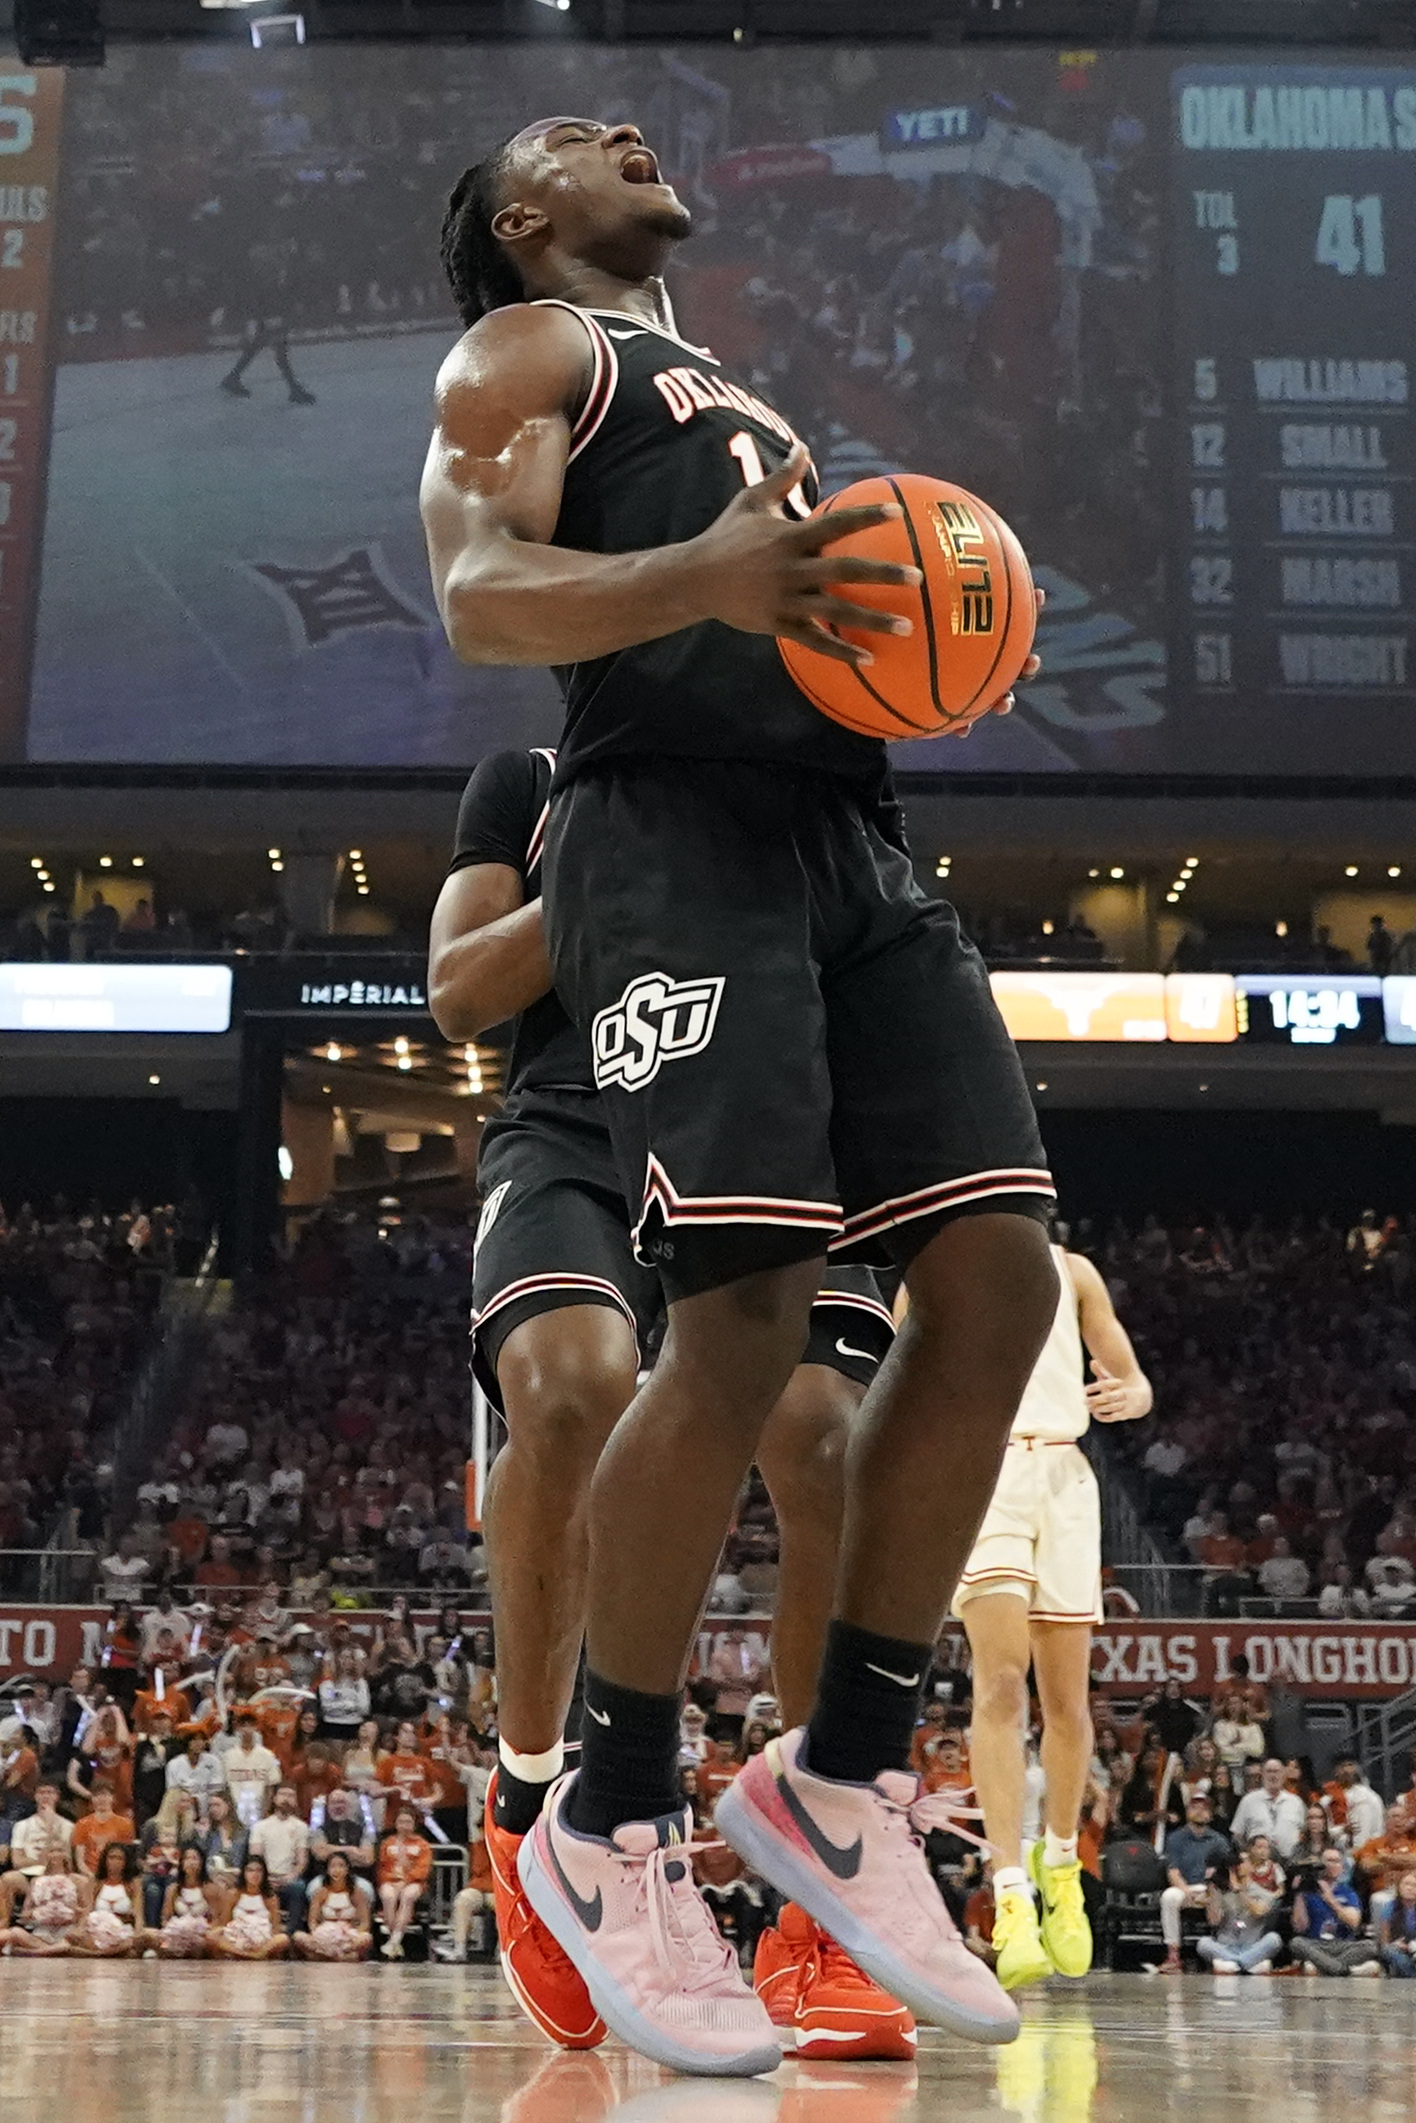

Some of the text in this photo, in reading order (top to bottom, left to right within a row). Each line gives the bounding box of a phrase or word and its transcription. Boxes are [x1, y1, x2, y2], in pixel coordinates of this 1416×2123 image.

[896, 107, 970, 141] YETI
[2, 229, 24, 268] 2
[1217, 234, 1239, 275] 3
[1315, 195, 1386, 276] 41
[1195, 359, 1407, 402] 5 WILLIAMS
[653, 367, 801, 446] OKLAHO
[1191, 424, 1388, 468] 12 SMALL
[1191, 488, 1393, 534] 14 KELLER
[1190, 556, 1400, 606] 32 MARSH
[1197, 633, 1407, 683] 51 WRIGHT
[592, 971, 726, 1093] OSU
[1092, 1635, 1416, 1684] XAS LONGHO
